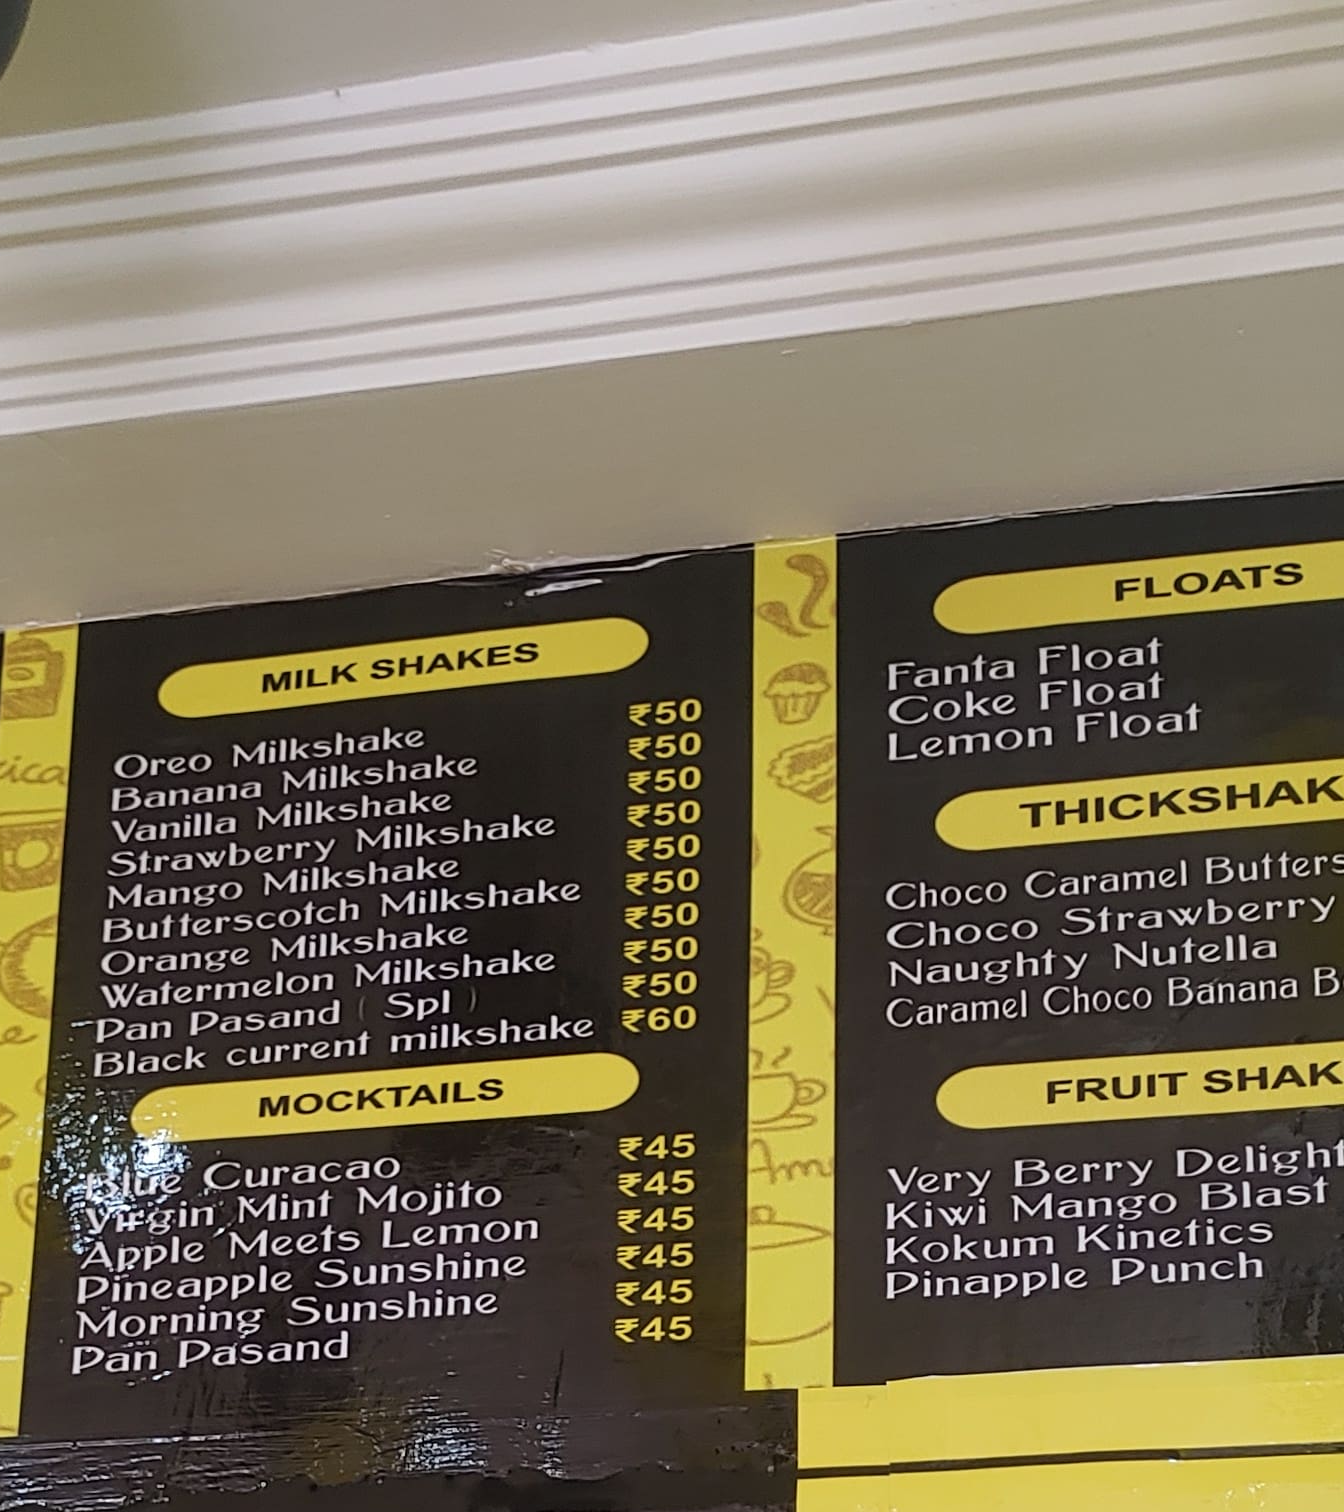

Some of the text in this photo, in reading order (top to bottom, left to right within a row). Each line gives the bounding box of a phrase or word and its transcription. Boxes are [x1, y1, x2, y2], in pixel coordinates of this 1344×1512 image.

[1115, 563, 1303, 601] FLOATS
[263, 643, 538, 693] MILK SHAKES
[889, 638, 1161, 690] Fanta Float
[889, 672, 1163, 724] Coke Float
[115, 699, 701, 778] Oreo Milkshake ₹50
[889, 727, 1052, 760] Lemon
[1077, 703, 1200, 742] Float
[112, 755, 476, 811] Banana Milkshake
[112, 791, 451, 842] Vanilla Milkshake
[108, 815, 554, 876] Strawberry Milkshake
[108, 857, 458, 909] Mango Milkshake
[886, 882, 1006, 909] Choco
[1025, 860, 1186, 898] Caramel
[103, 880, 580, 942] Butterscotch Milkshake
[887, 896, 1335, 948] Choco Strawberry
[101, 923, 467, 975] Orange Milkshake
[890, 935, 1276, 986] Naughty Nutella
[101, 950, 554, 1008] Watermelon Milkshake
[887, 990, 1026, 1027] Caramel
[1043, 986, 1151, 1015] Choco
[1168, 978, 1297, 1006] Banana
[94, 1016, 593, 1077] Black current milkshake
[259, 1079, 503, 1117] MOCKTAILS
[1048, 1072, 1188, 1104] FRUIT
[888, 1167, 990, 1196] Very
[1015, 1154, 1152, 1186] Berry
[887, 1176, 1328, 1229] Kiwi Mango Blast
[81, 1207, 693, 1272] Apple Meets Lemon ₹45
[887, 1219, 1272, 1264] Kokum Kinetics
[78, 1254, 525, 1304] Pineapple Sunshine
[887, 1252, 1262, 1299] Pinapple Punch
[76, 1291, 497, 1338] Morning Sunshine
[72, 1331, 348, 1374] Pan Pasand
